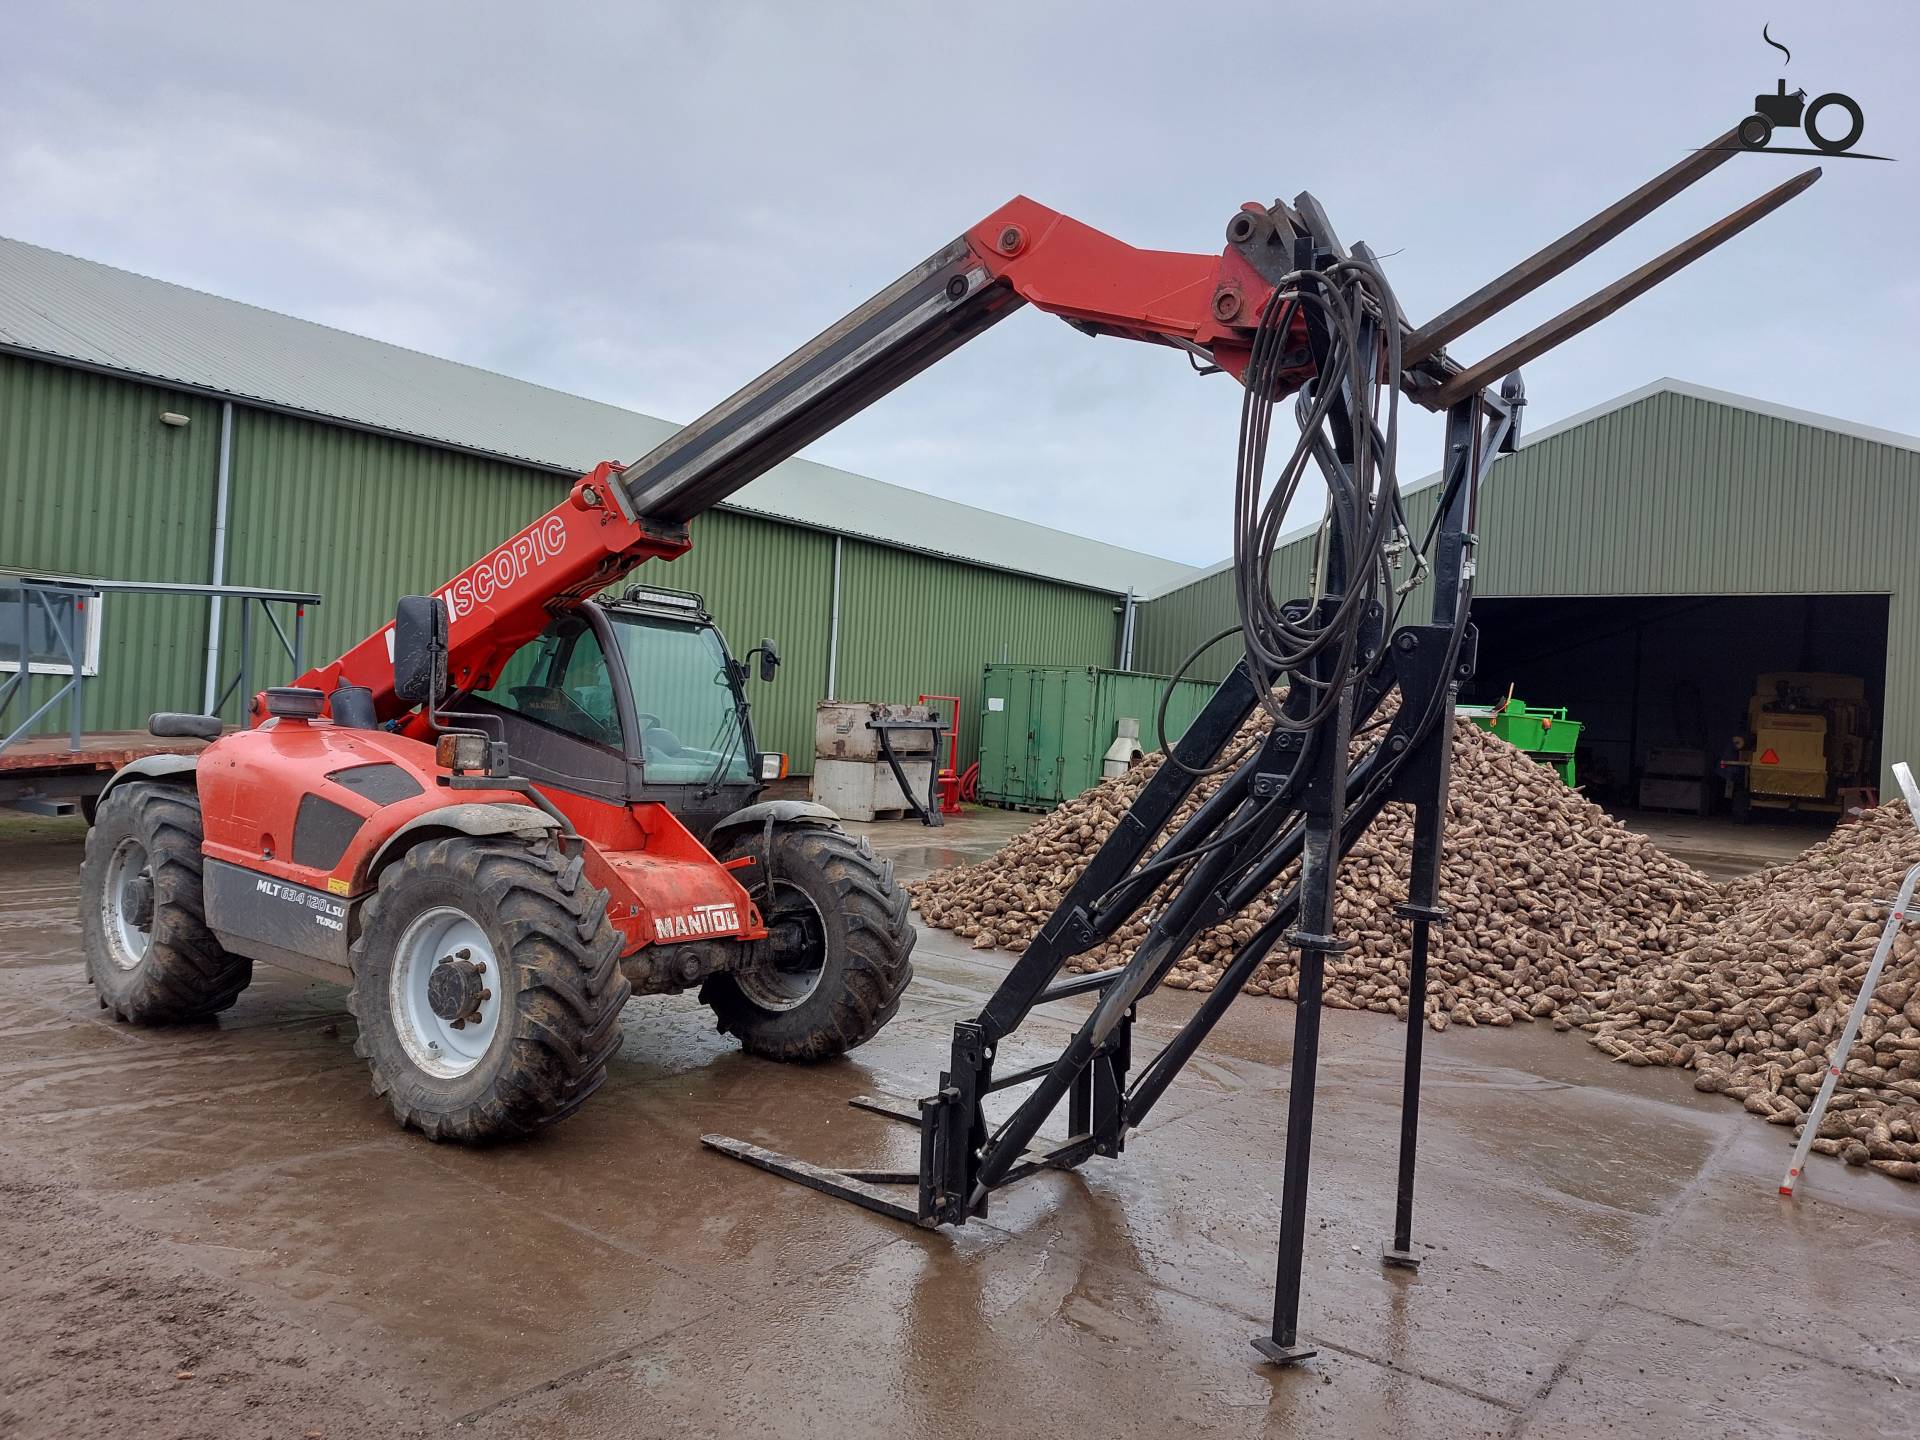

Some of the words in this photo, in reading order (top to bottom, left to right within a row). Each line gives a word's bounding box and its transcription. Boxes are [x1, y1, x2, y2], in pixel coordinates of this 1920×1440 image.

[384, 515, 567, 664] ISCOPIC
[256, 879, 282, 897] MLT
[280, 887, 305, 905] 634
[306, 894, 327, 912] 120
[325, 903, 346, 918] LSU
[315, 914, 344, 931] TURBO
[654, 902, 740, 939] MANITOU
